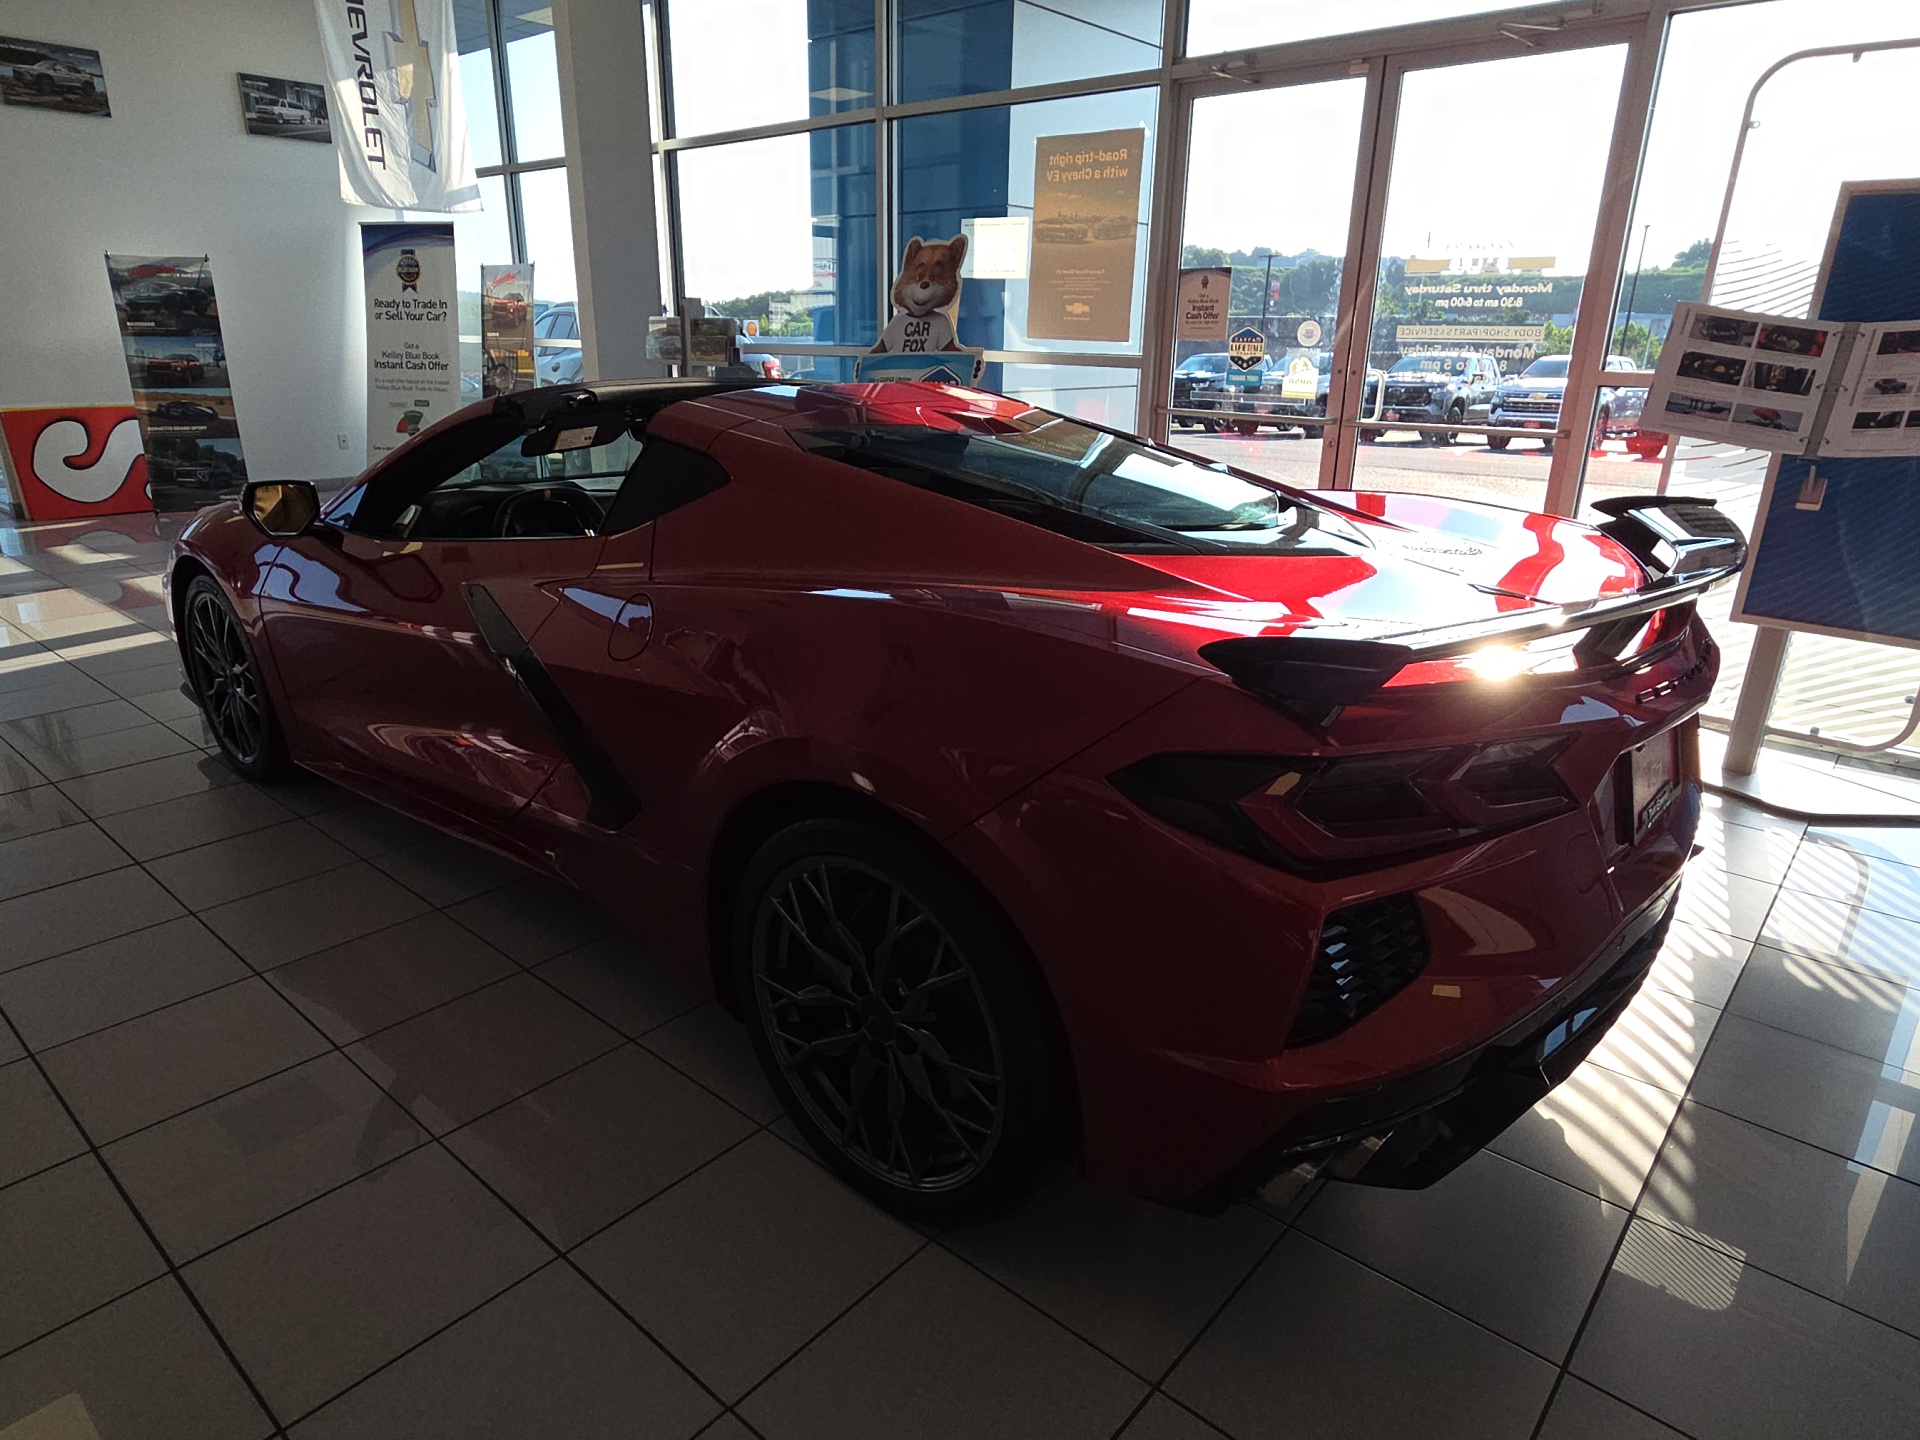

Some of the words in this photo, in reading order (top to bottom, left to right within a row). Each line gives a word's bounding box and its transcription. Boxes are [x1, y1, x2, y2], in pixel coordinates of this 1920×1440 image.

[374, 298, 400, 310] Ready
[402, 299, 411, 308] to
[412, 299, 437, 309] Trade
[439, 299, 447, 309] In
[374, 312, 383, 320] or
[385, 311, 402, 320] Sell
[404, 311, 424, 321] Your
[426, 311, 447, 321] Car?
[904, 321, 931, 337] CAR
[902, 339, 927, 352] FOX
[382, 351, 404, 361] Kelley
[405, 351, 420, 359] Blue
[422, 352, 440, 360] Book
[374, 359, 404, 369] Instant
[405, 361, 426, 370] Cash
[428, 361, 450, 370] Offer
